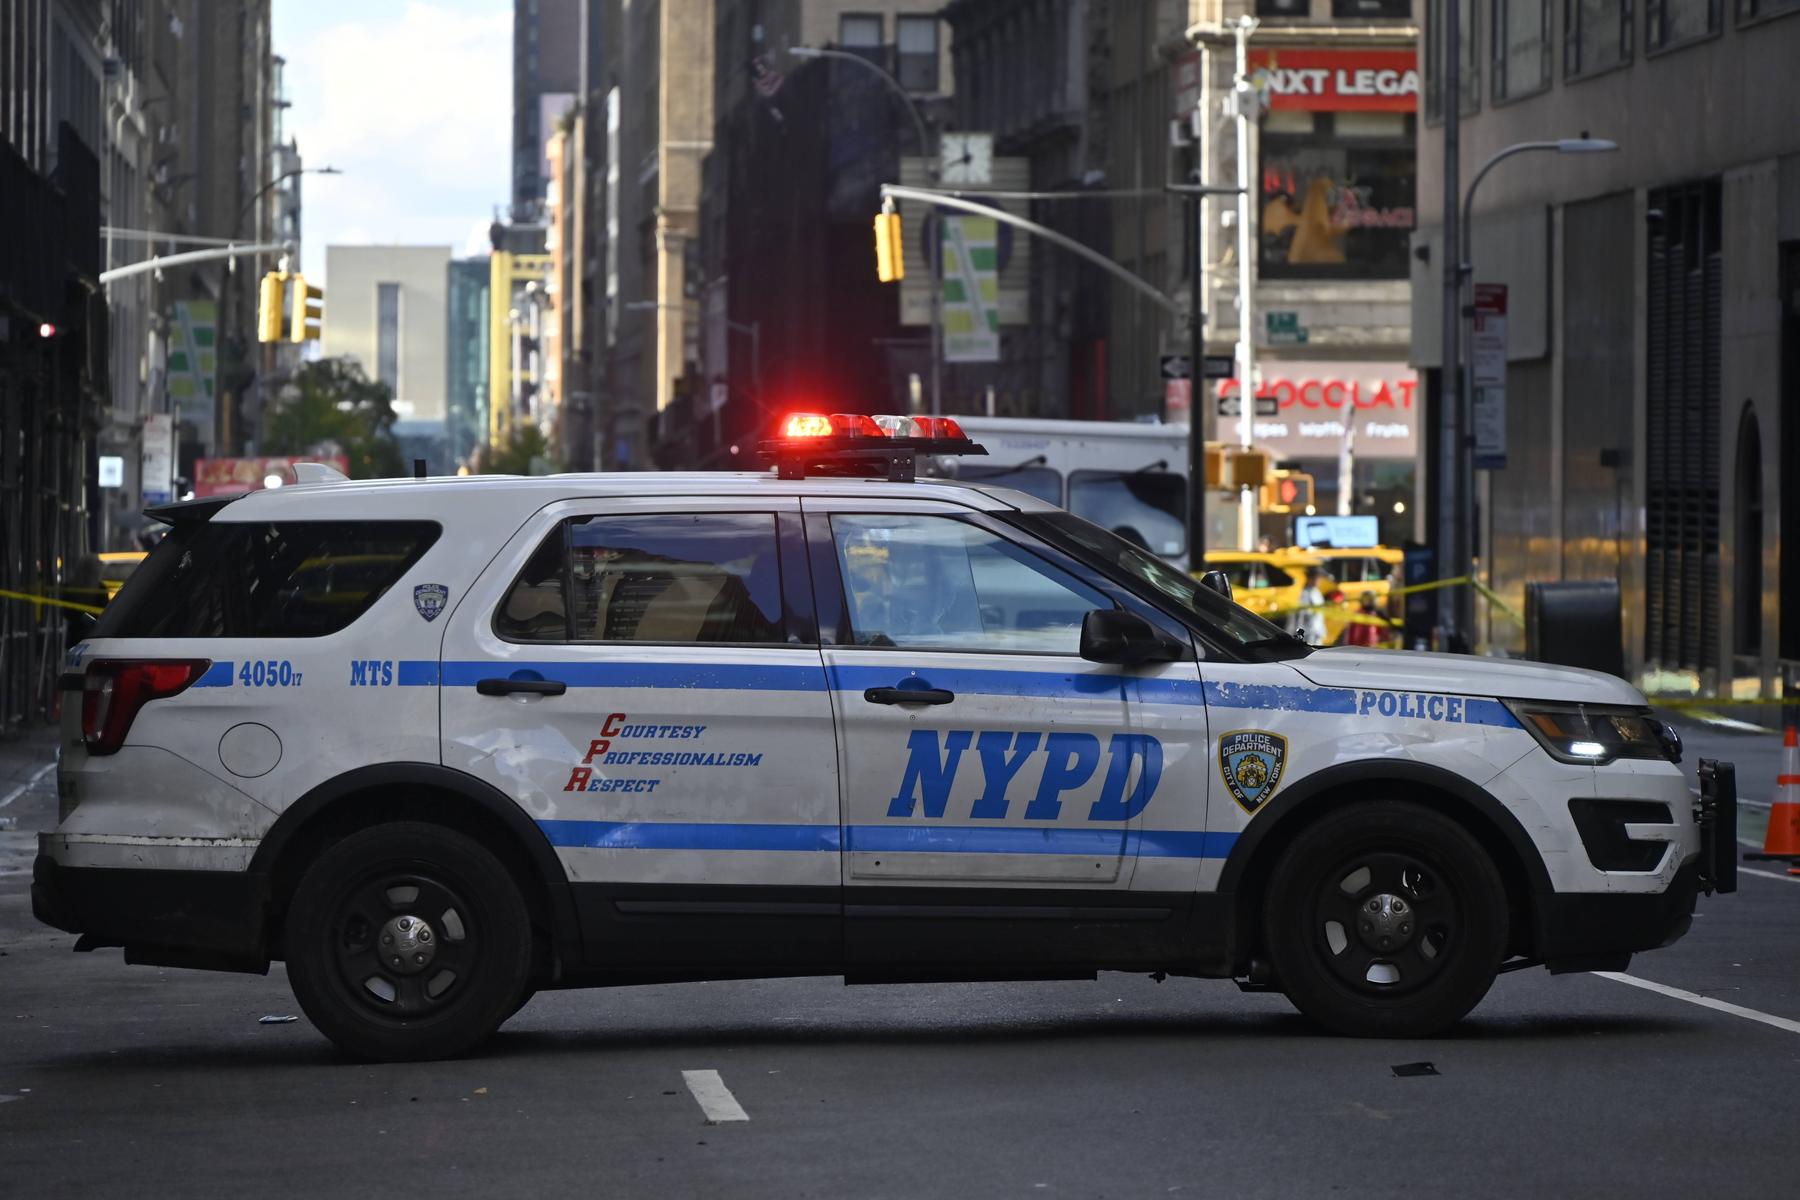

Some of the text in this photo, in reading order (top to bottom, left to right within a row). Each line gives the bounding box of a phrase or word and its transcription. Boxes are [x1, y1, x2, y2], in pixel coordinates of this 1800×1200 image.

[1267, 69, 1330, 94] NXT
[239, 660, 292, 687] 4050
[350, 660, 392, 686] MTS
[1359, 691, 1462, 723] POLICE
[600, 713, 707, 739] COURTESY
[1223, 743, 1282, 757] DEPARTMENT
[1235, 734, 1271, 745] POLICE
[581, 740, 763, 766] PROFESSIONALISM
[563, 767, 660, 793] RESPECT
[886, 730, 1164, 821] NYPD
[1223, 766, 1245, 800] CITY OF
[1256, 762, 1282, 804] NEW YORK
